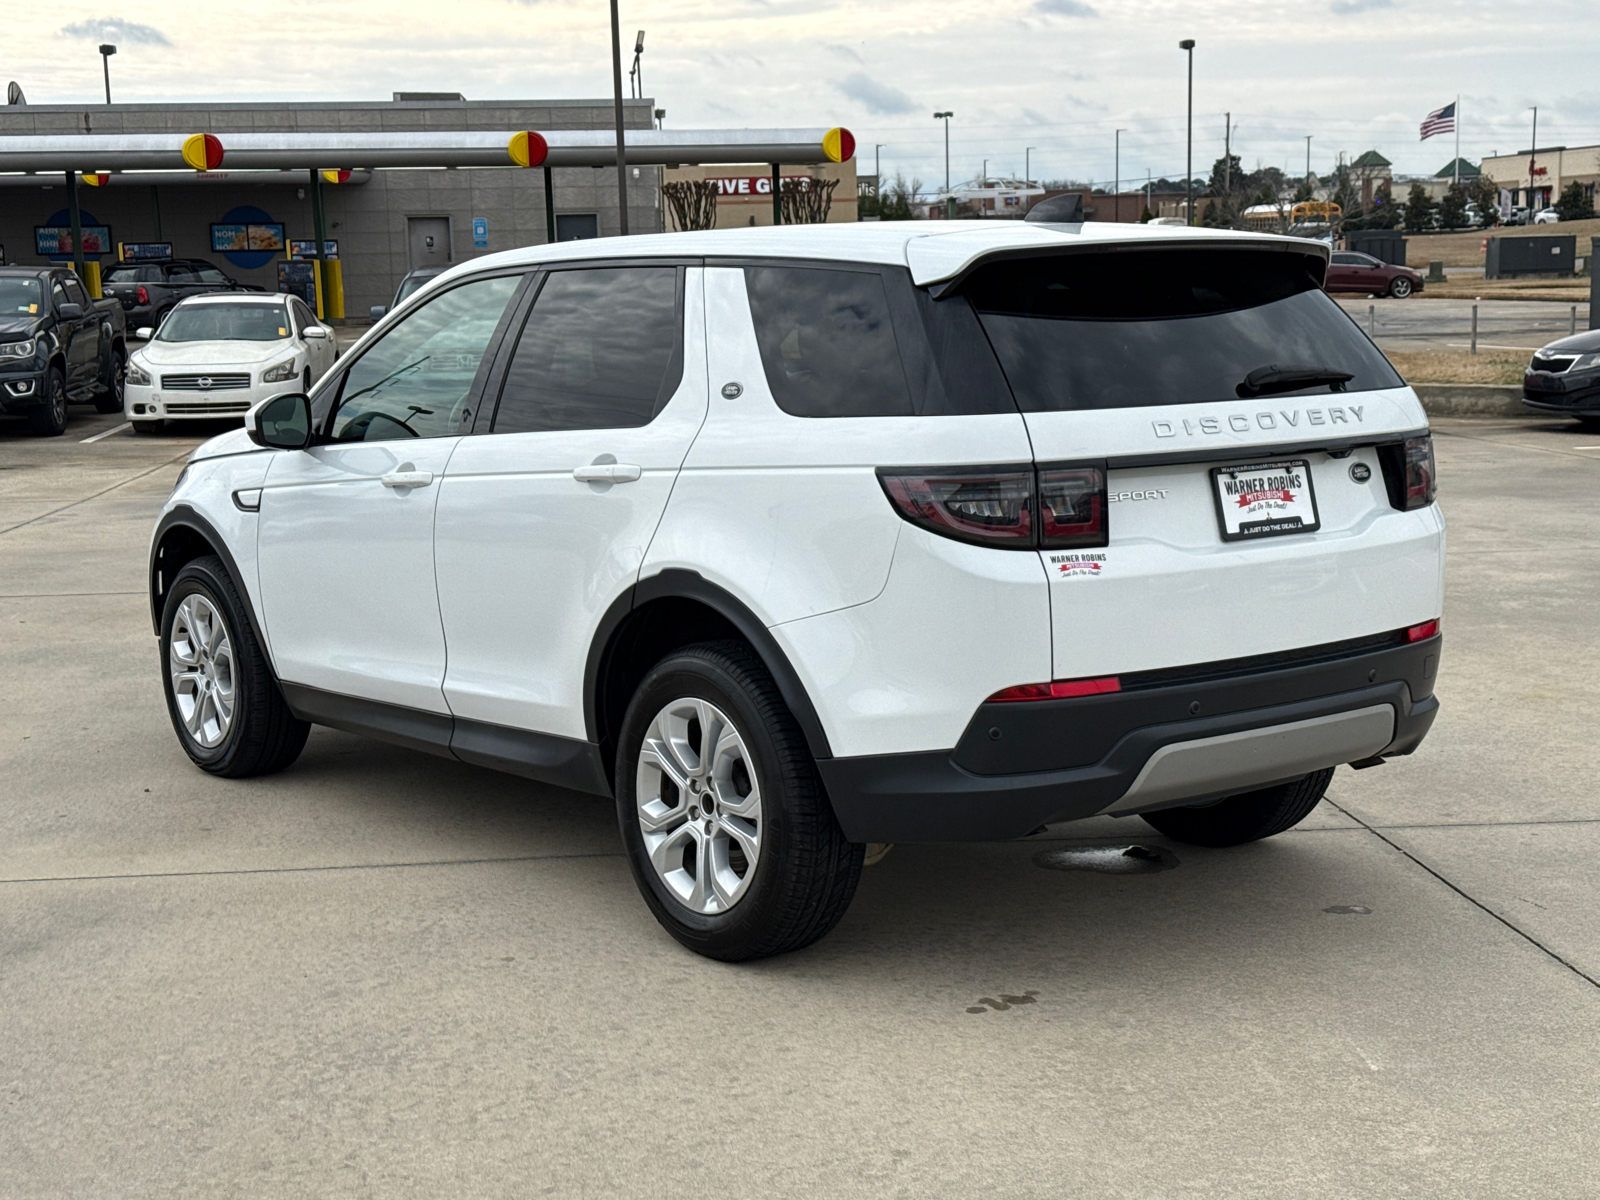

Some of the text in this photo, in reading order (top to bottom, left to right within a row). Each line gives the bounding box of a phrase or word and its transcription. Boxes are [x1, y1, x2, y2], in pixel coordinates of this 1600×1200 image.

[215, 230, 235, 238] NOM
[1152, 405, 1364, 438] DISCOVERY
[1224, 474, 1302, 496] WARNER ROBINS
[1108, 488, 1169, 503] SPORT
[1246, 490, 1284, 502] MITSUBISHI
[1246, 504, 1257, 514] Just
[1257, 502, 1264, 511] Do
[1264, 501, 1273, 509] The
[1249, 526, 1262, 534] JUST
[1281, 522, 1297, 530] DEAL!
[1050, 553, 1107, 564] WARNER ROBINS
